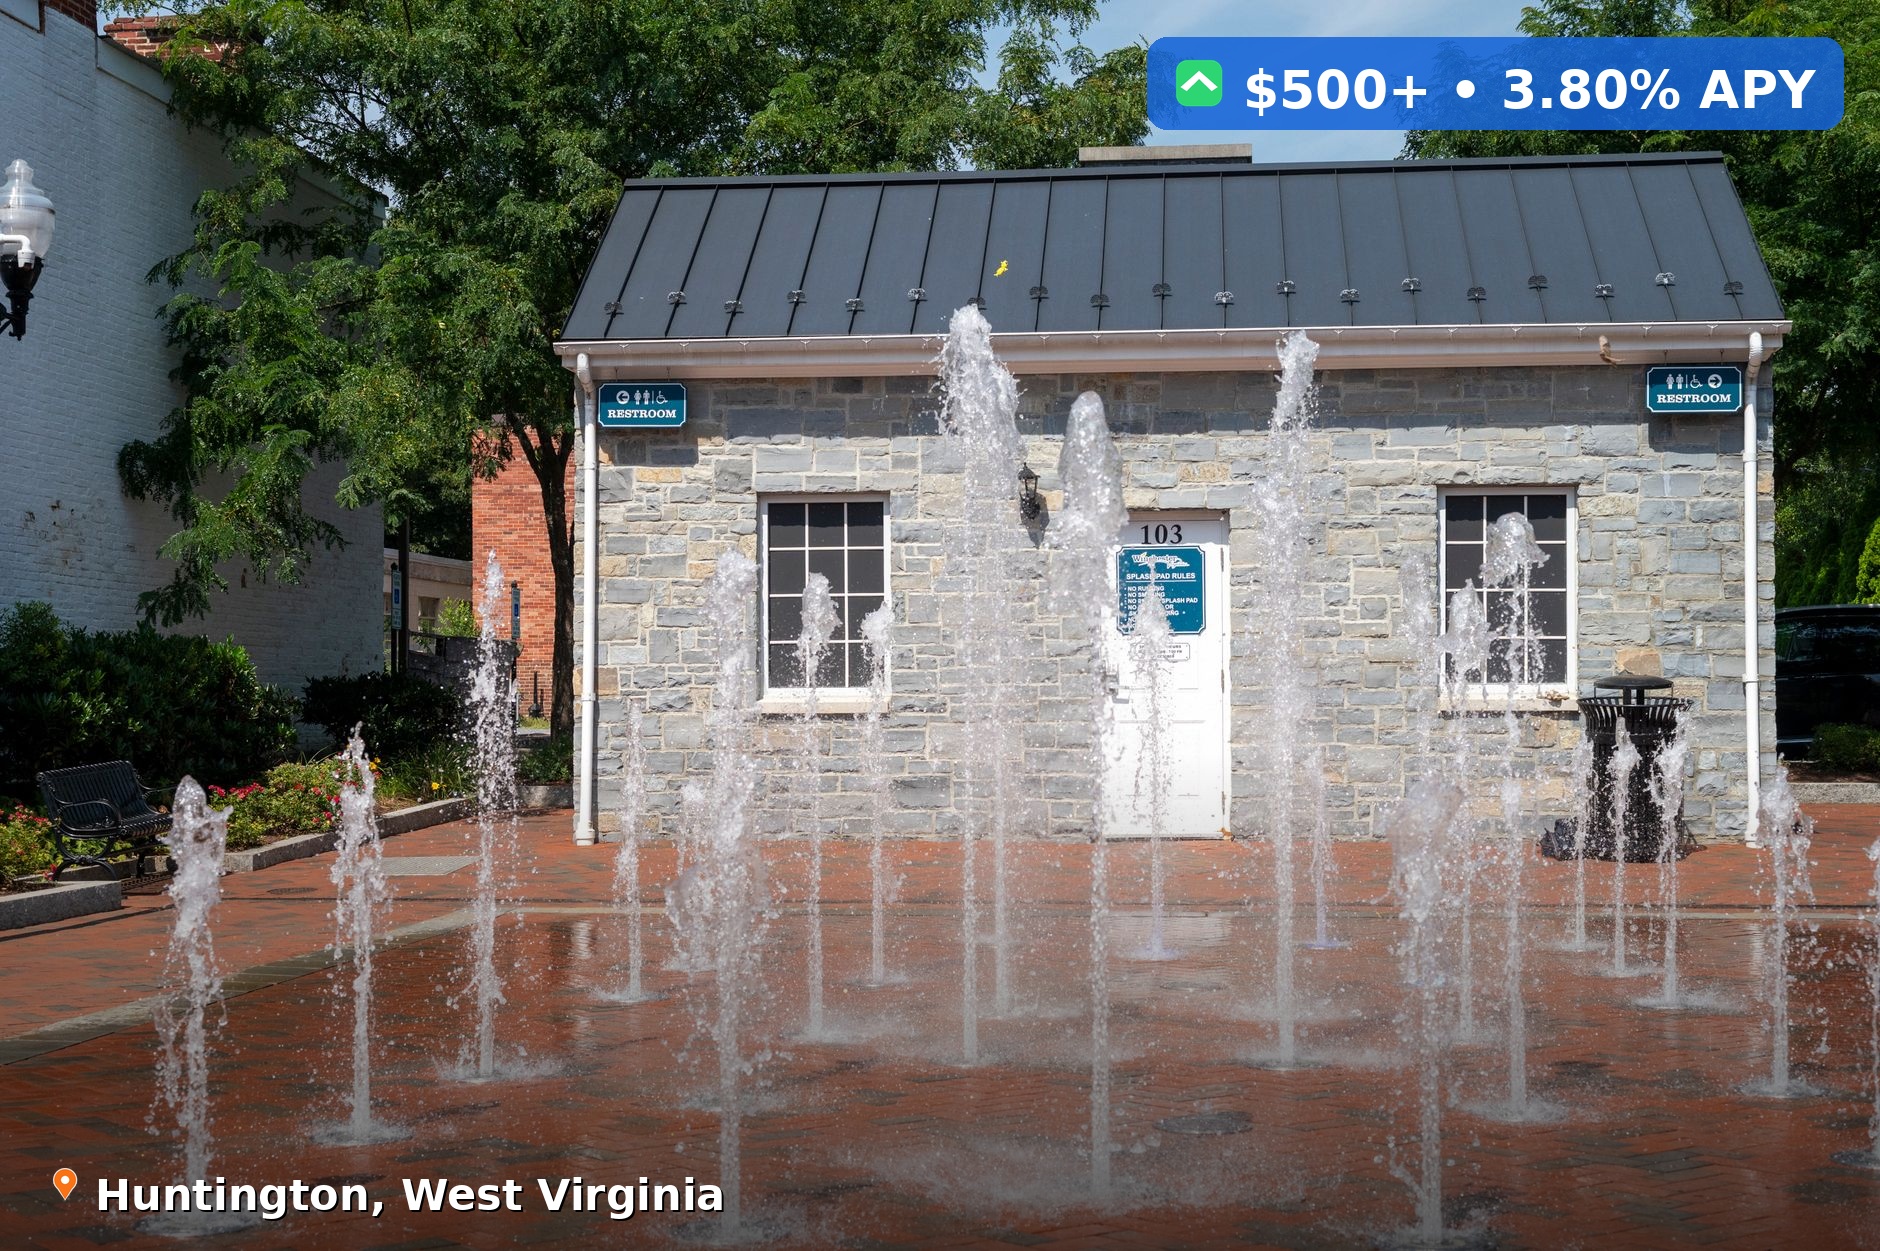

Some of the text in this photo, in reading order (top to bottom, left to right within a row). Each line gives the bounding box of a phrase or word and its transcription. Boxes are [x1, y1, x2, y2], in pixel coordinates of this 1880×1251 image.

[1656, 393, 1732, 403] RESTROOM
[607, 409, 677, 418] RESTROOM
[1140, 523, 1183, 545] 103
[1156, 572, 1171, 580] PAD
